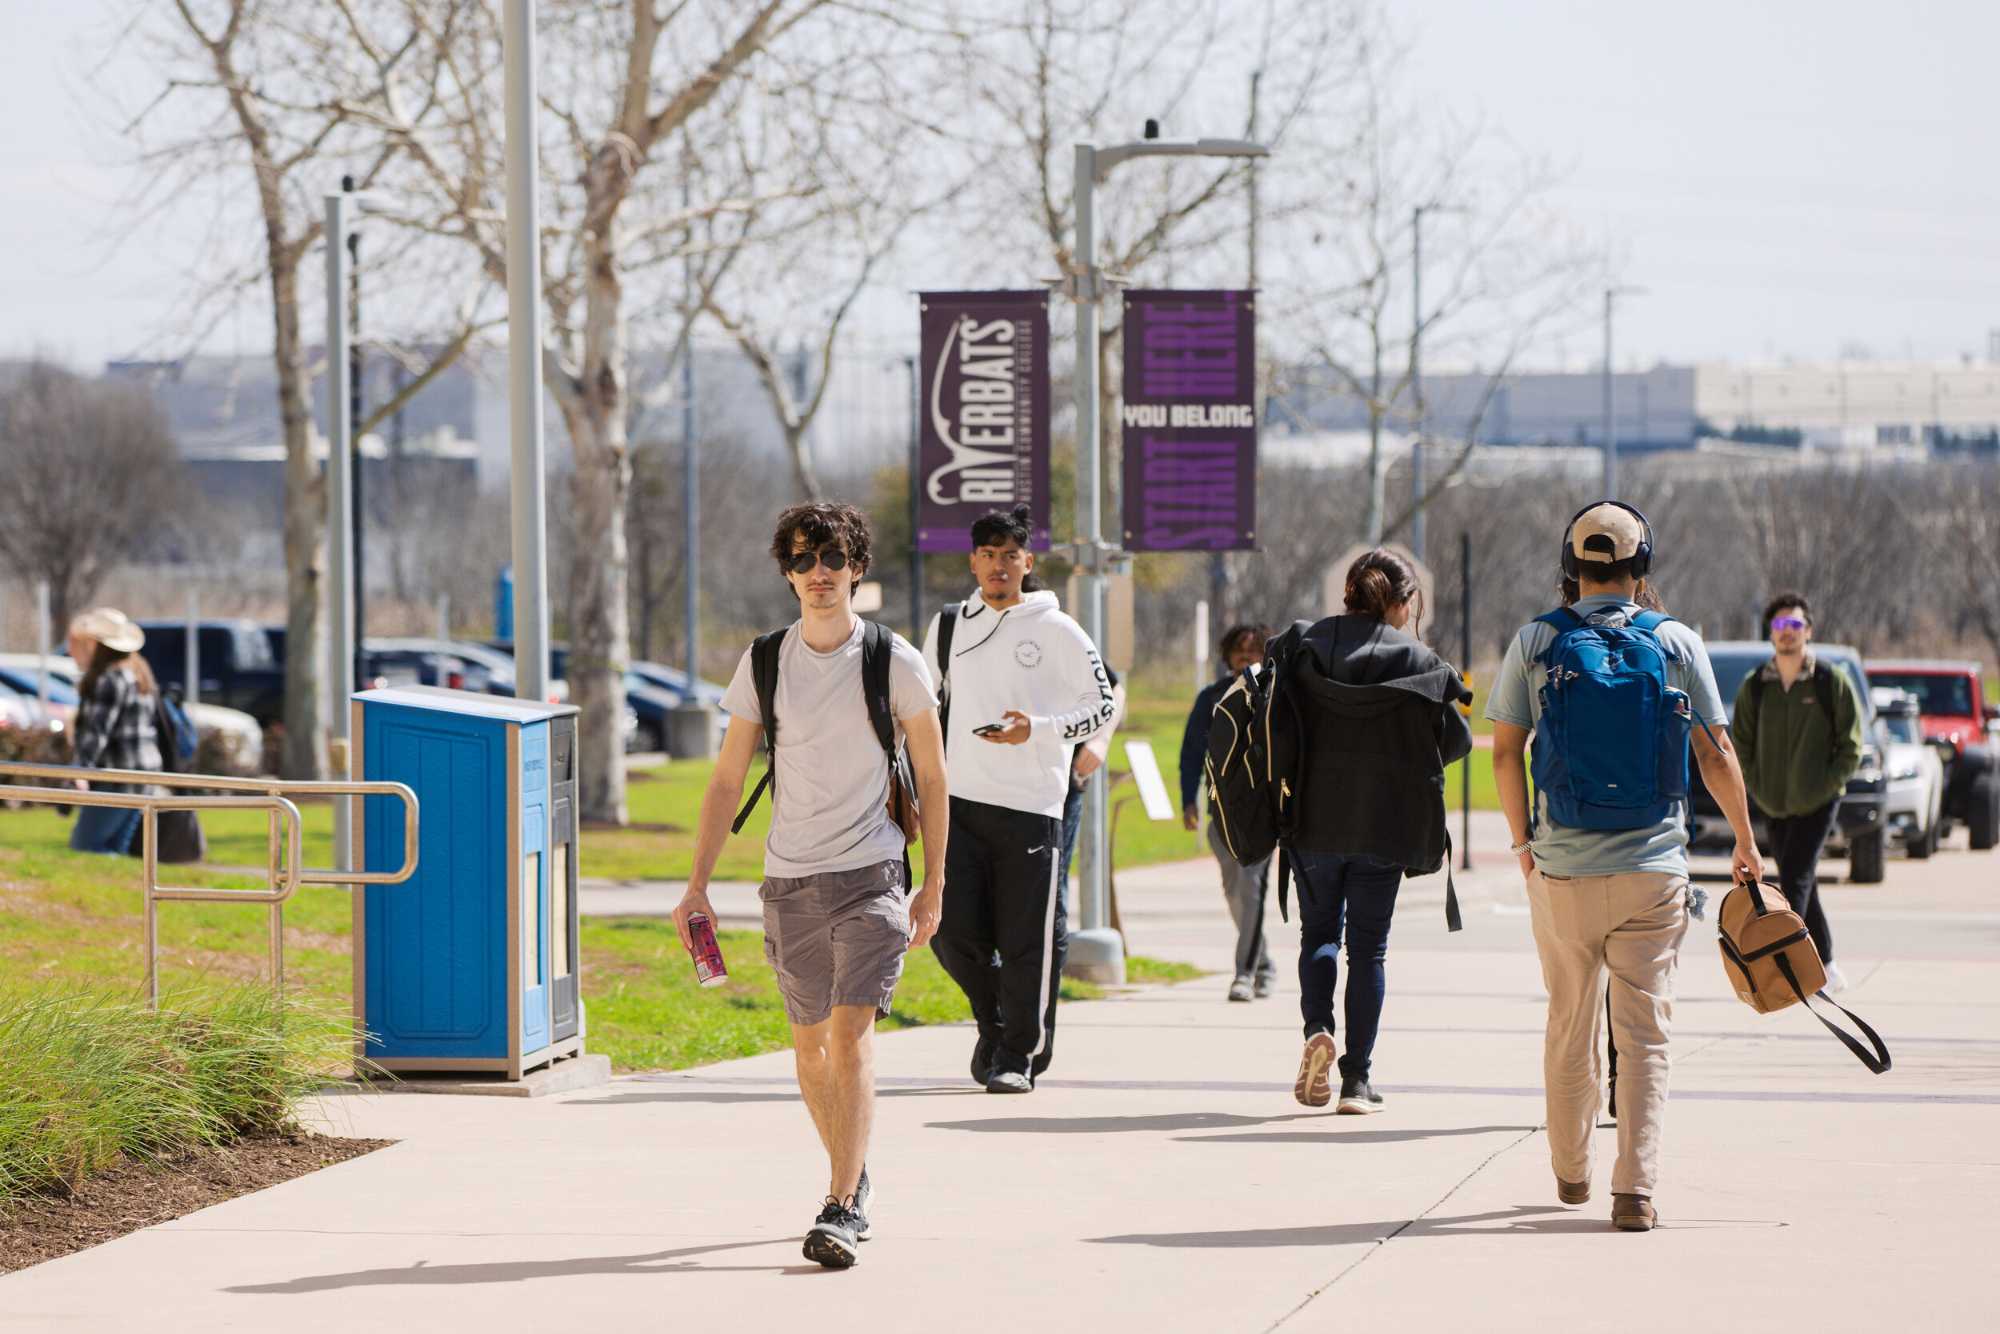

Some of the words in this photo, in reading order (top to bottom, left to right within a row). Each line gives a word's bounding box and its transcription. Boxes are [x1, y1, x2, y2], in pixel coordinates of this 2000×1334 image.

[927, 318, 1018, 505] RIVERBATS
[1124, 404, 1167, 427] YOU
[1169, 404, 1253, 427] BELONG
[1144, 435, 1237, 549] START
[1063, 650, 1114, 739] HOLLSTER
